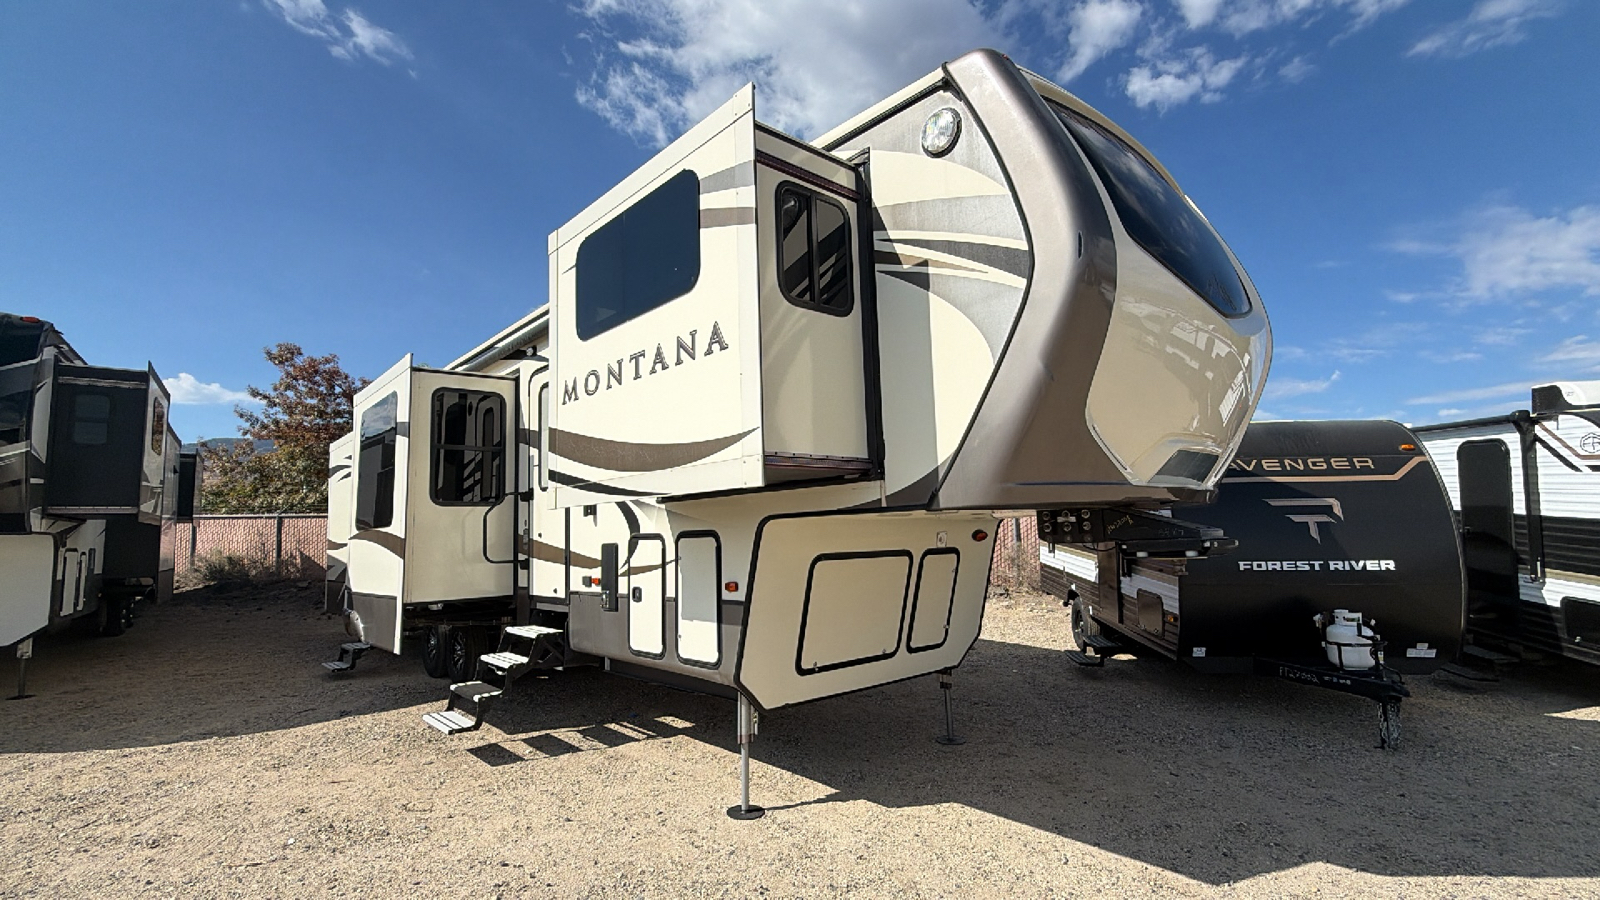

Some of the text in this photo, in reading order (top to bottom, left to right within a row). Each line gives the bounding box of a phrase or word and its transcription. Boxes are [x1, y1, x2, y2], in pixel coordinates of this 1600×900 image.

[561, 320, 729, 406] MONTANA
[1237, 559, 1397, 572] FOREST RIVER
